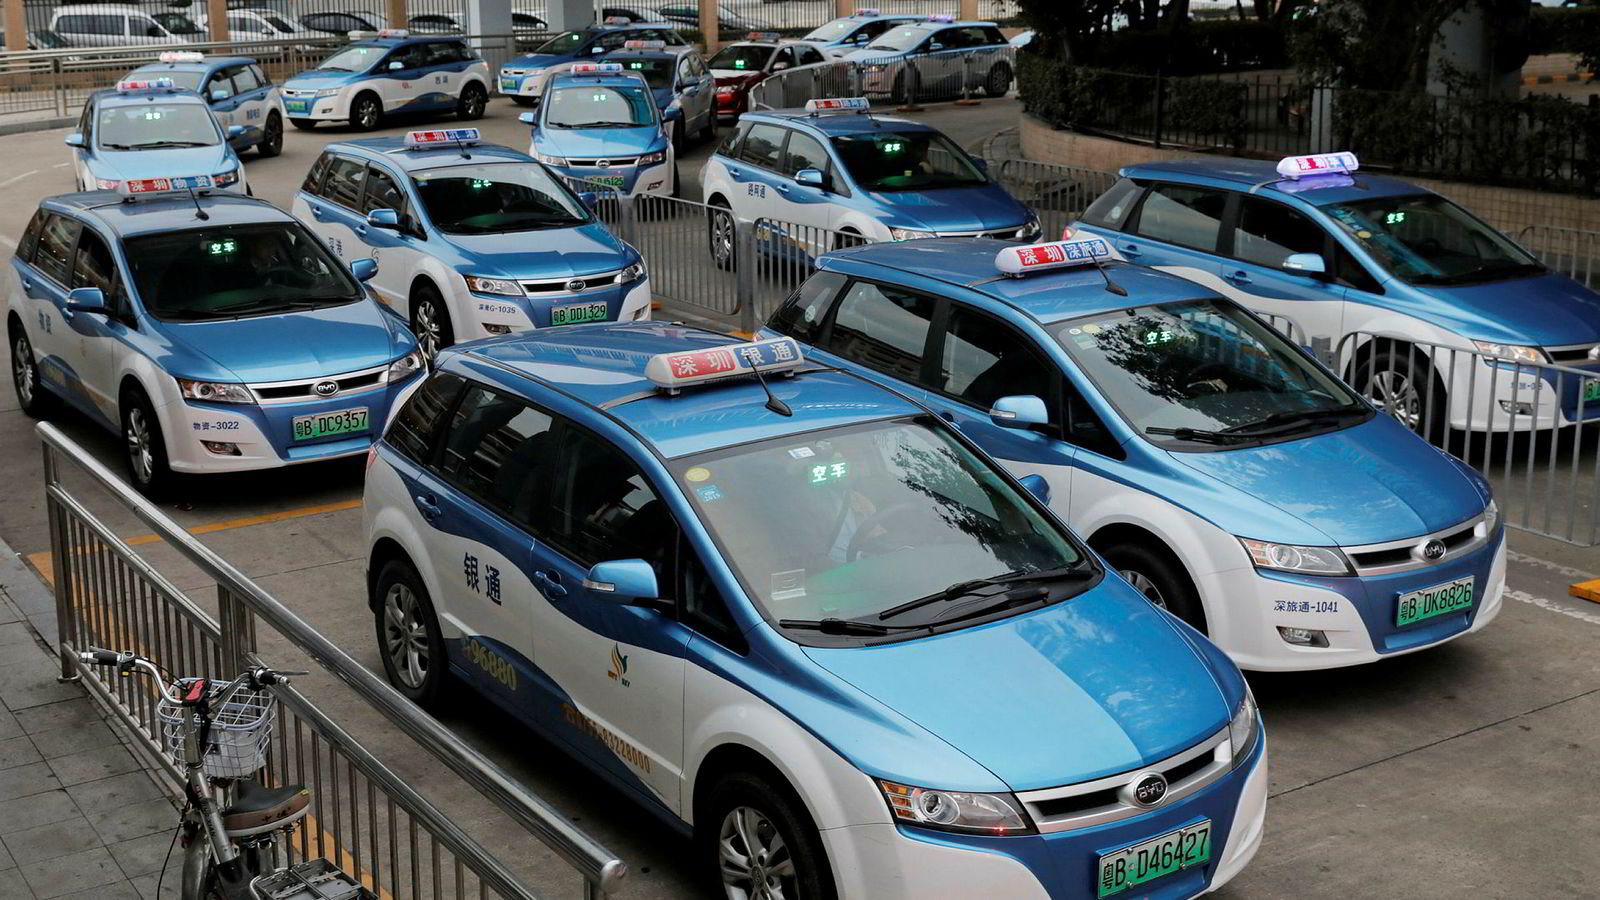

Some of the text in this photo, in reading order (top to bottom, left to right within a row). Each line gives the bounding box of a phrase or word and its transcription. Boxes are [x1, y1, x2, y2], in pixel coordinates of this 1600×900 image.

[131, 181, 168, 192] 深圳
[211, 242, 235, 254] 空车
[1021, 241, 1108, 265] 深圳 深旅通
[1146, 330, 1173, 345] 空车
[673, 342, 794, 376] 深圳 银通
[811, 461, 847, 483] 空车
[463, 551, 502, 607] 银通
[1273, 599, 1339, 614] 深旅通-1041
[469, 638, 518, 691] 96880
[1137, 781, 1165, 799] BYD
